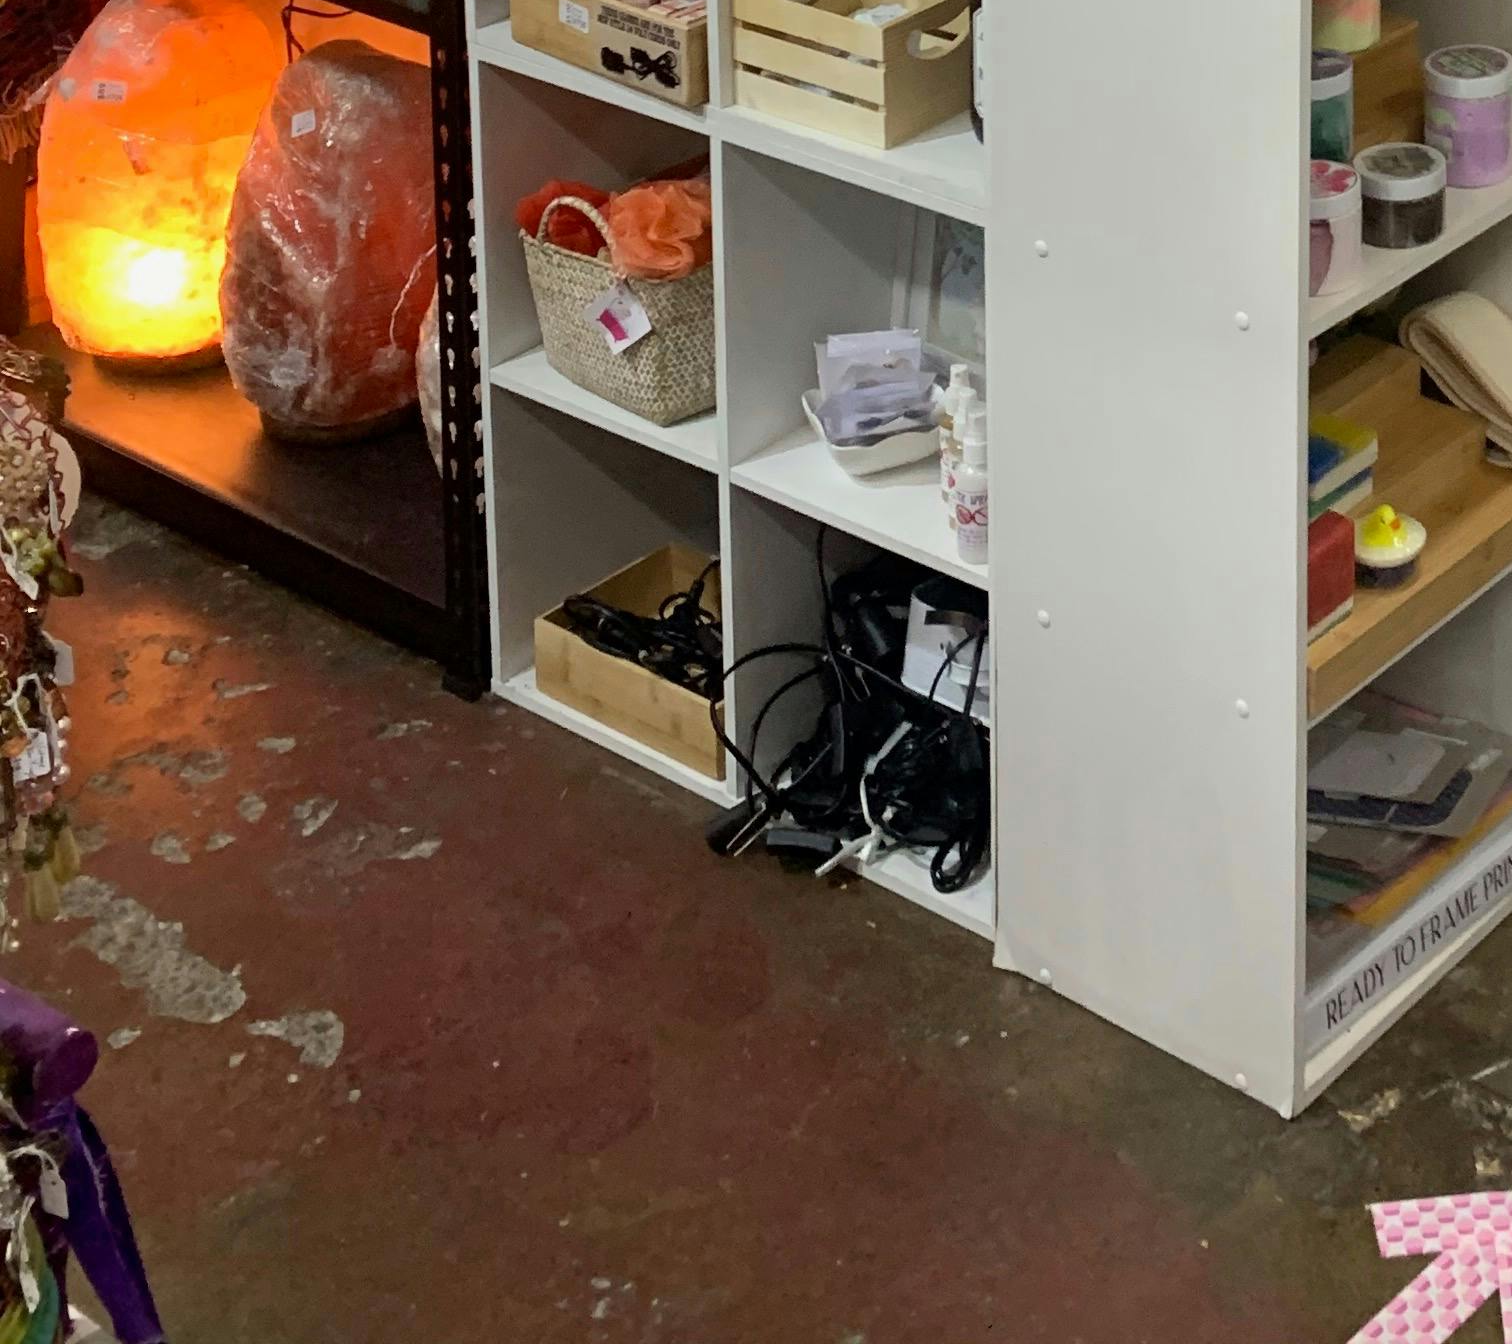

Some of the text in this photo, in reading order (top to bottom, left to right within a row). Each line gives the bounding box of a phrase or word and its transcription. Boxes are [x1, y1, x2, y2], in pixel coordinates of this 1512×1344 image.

[1325, 961, 1384, 1030] READY
[1393, 935, 1418, 971] TO
[1419, 881, 1480, 953] FRAME
